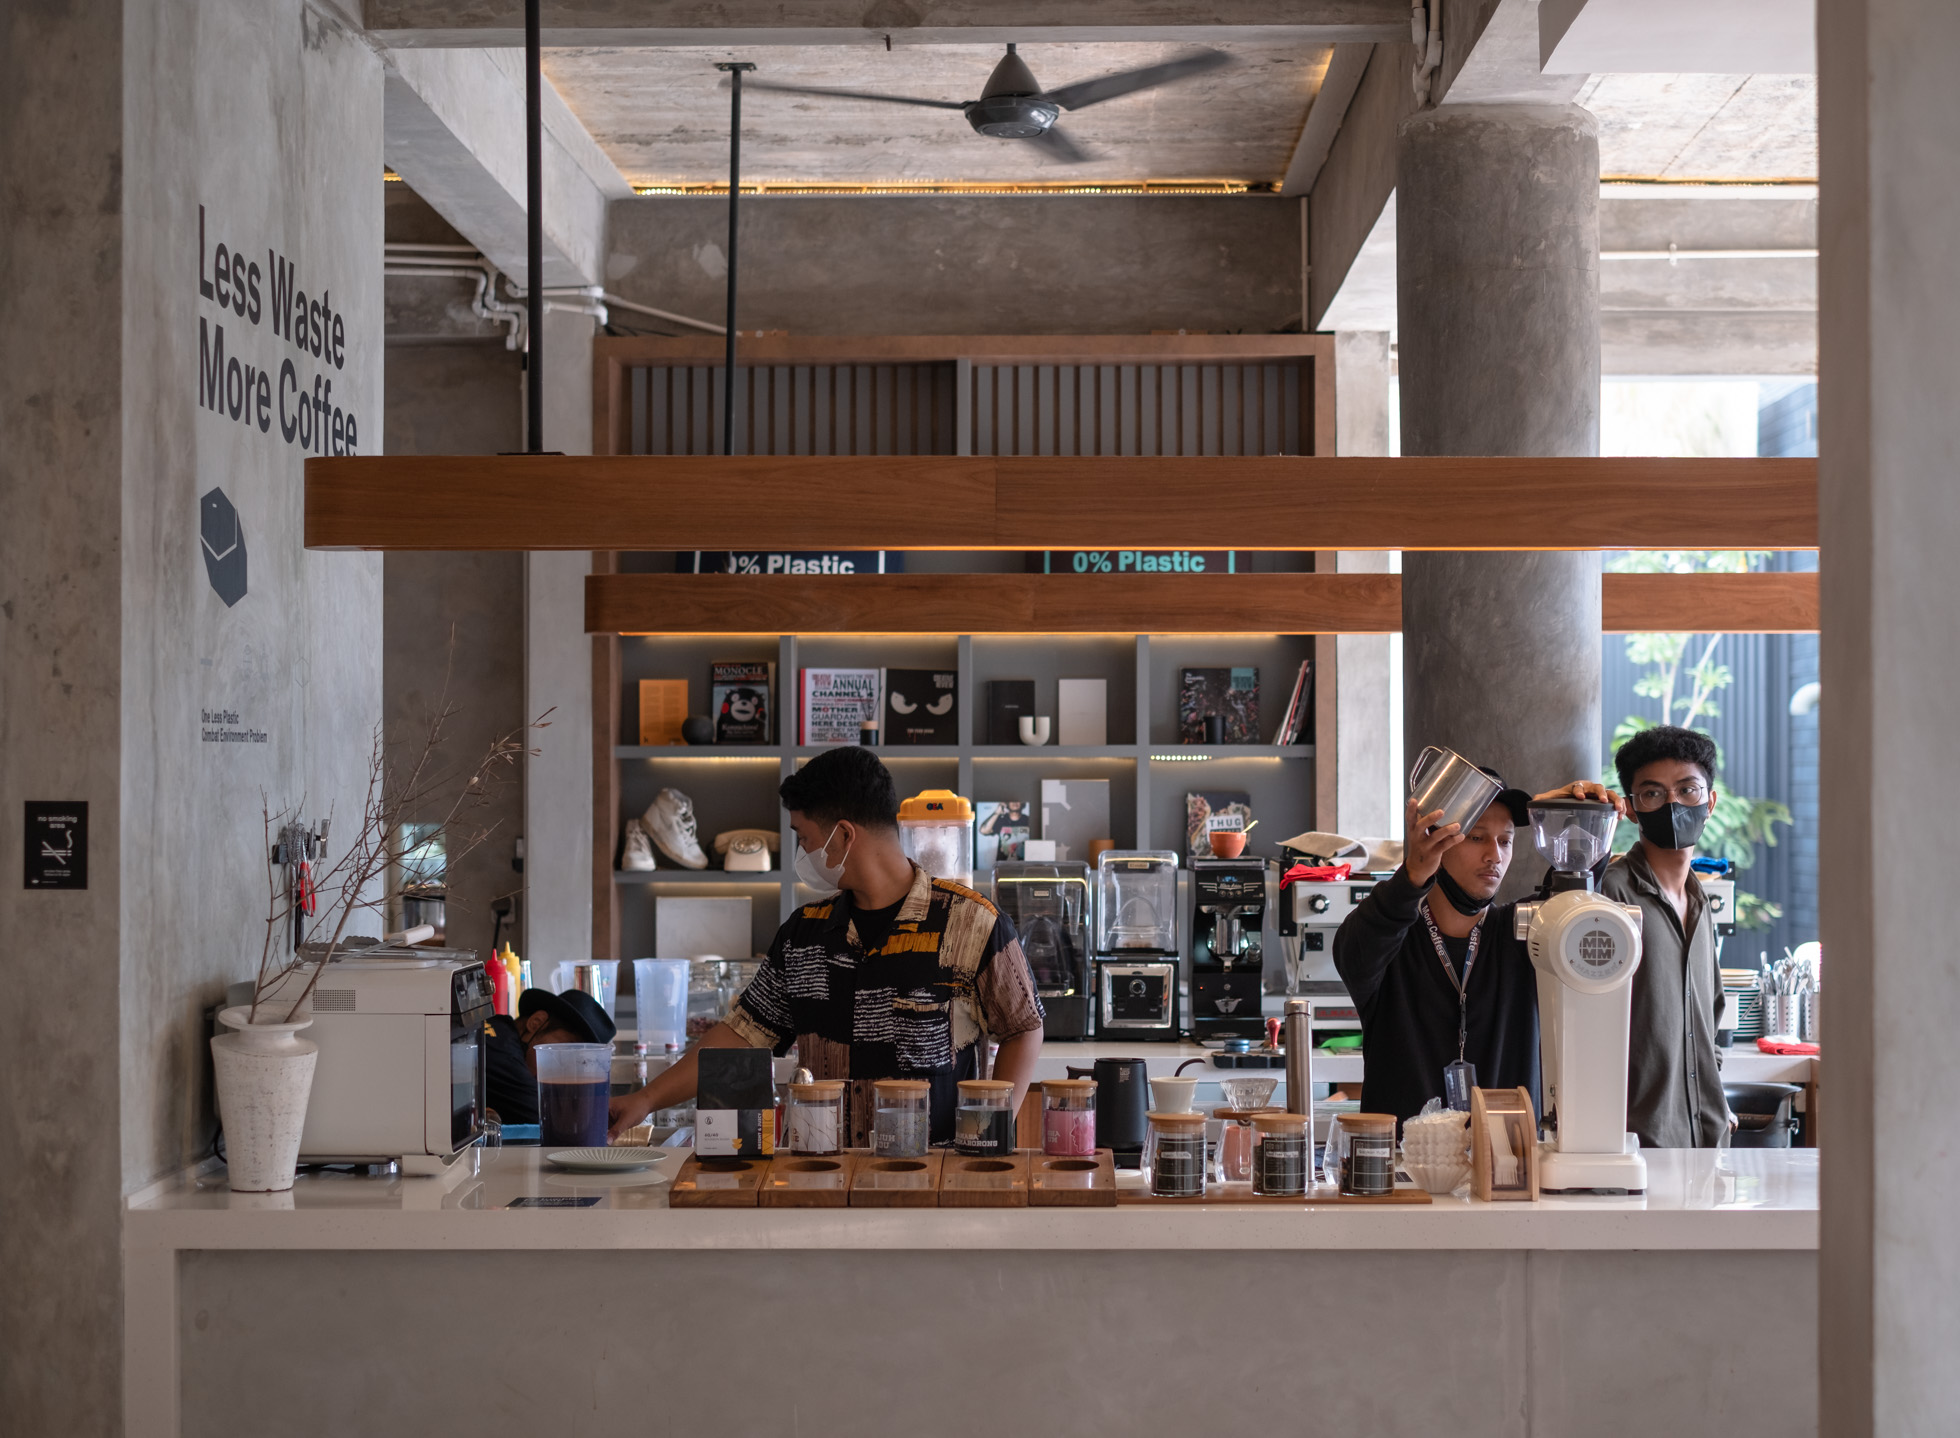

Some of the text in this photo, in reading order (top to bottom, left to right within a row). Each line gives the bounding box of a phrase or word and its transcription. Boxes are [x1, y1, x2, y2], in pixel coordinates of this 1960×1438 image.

[199, 204, 345, 370] Less Waste
[199, 316, 357, 457] More Coffee
[767, 554, 855, 574] Plastic
[1072, 551, 1206, 573] 0% Plastic
[714, 666, 763, 675] MONOCLE
[832, 679, 874, 690] ANNUAL
[201, 708, 239, 725] One Less Plastic
[202, 728, 268, 743] Combat Environment Problem
[48, 815, 78, 823] smoking
[1209, 818, 1241, 828] THUG
[1422, 904, 1445, 957] More Coffee
[1575, 962, 1618, 977] MAZZER
